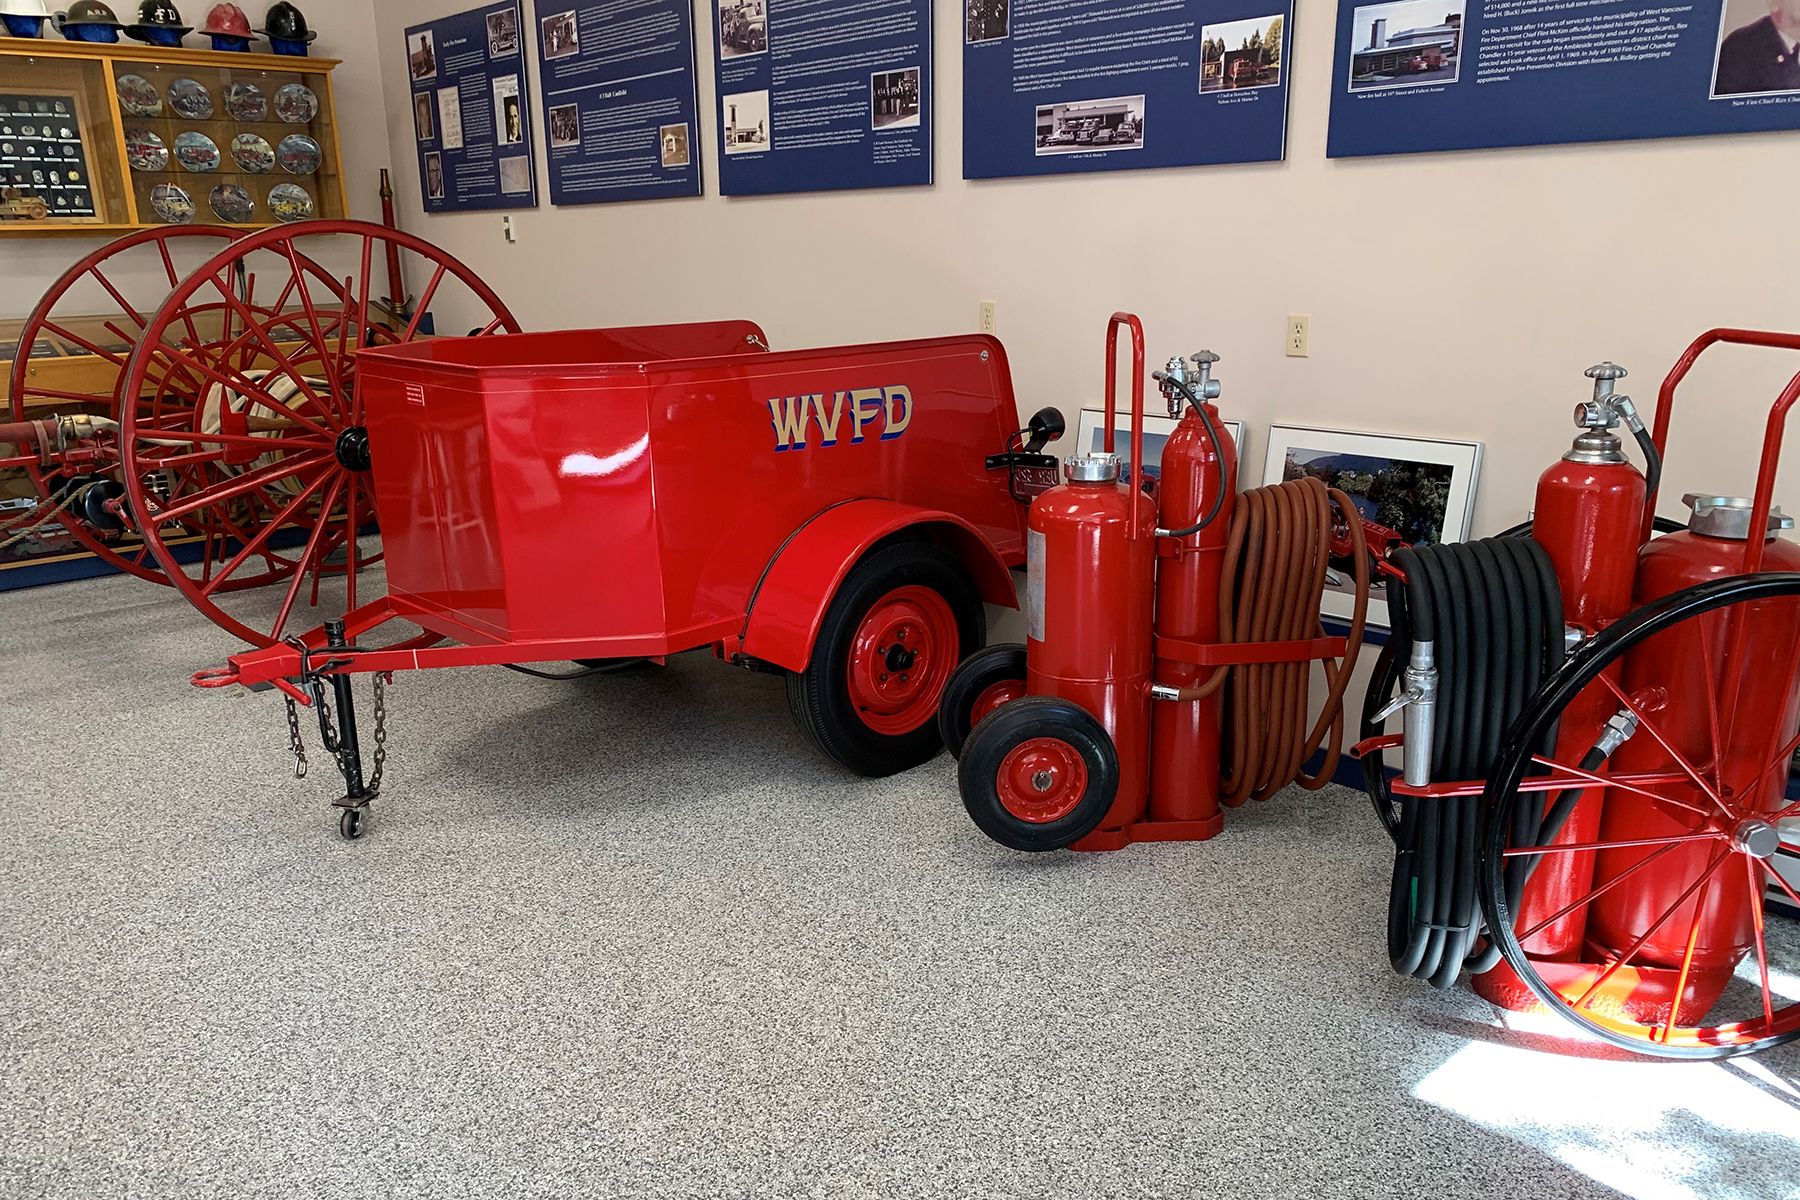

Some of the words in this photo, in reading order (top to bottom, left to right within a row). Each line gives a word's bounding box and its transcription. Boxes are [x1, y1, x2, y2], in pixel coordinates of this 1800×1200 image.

[1484, 10, 1496, 19] hired
[1504, 9, 1520, 17] (Buck)
[1603, 11, 1639, 20] municipality
[1661, 5, 1693, 13] Vancouver
[1491, 34, 1522, 42] Department
[1550, 28, 1569, 36] McKim
[1569, 25, 1592, 34] officially
[1593, 22, 1614, 30] handed
[1553, 36, 1571, 44] began
[1571, 31, 1606, 41] immediately
[1479, 60, 1500, 68] selected
[1523, 55, 1538, 63] office
[1649, 41, 1676, 50] Chandler
[1507, 50, 1526, 58] 15-year
[1564, 42, 1592, 50] Ambleside
[1594, 39, 1623, 47] volunteers
[1631, 35, 1651, 43] district
[1478, 67, 1506, 76] established
[1526, 62, 1555, 70] Prevention
[1556, 60, 1578, 68] Division
[1620, 54, 1639, 62] Ridley
[1639, 52, 1661, 61] getting
[768, 384, 913, 452] WVFD
